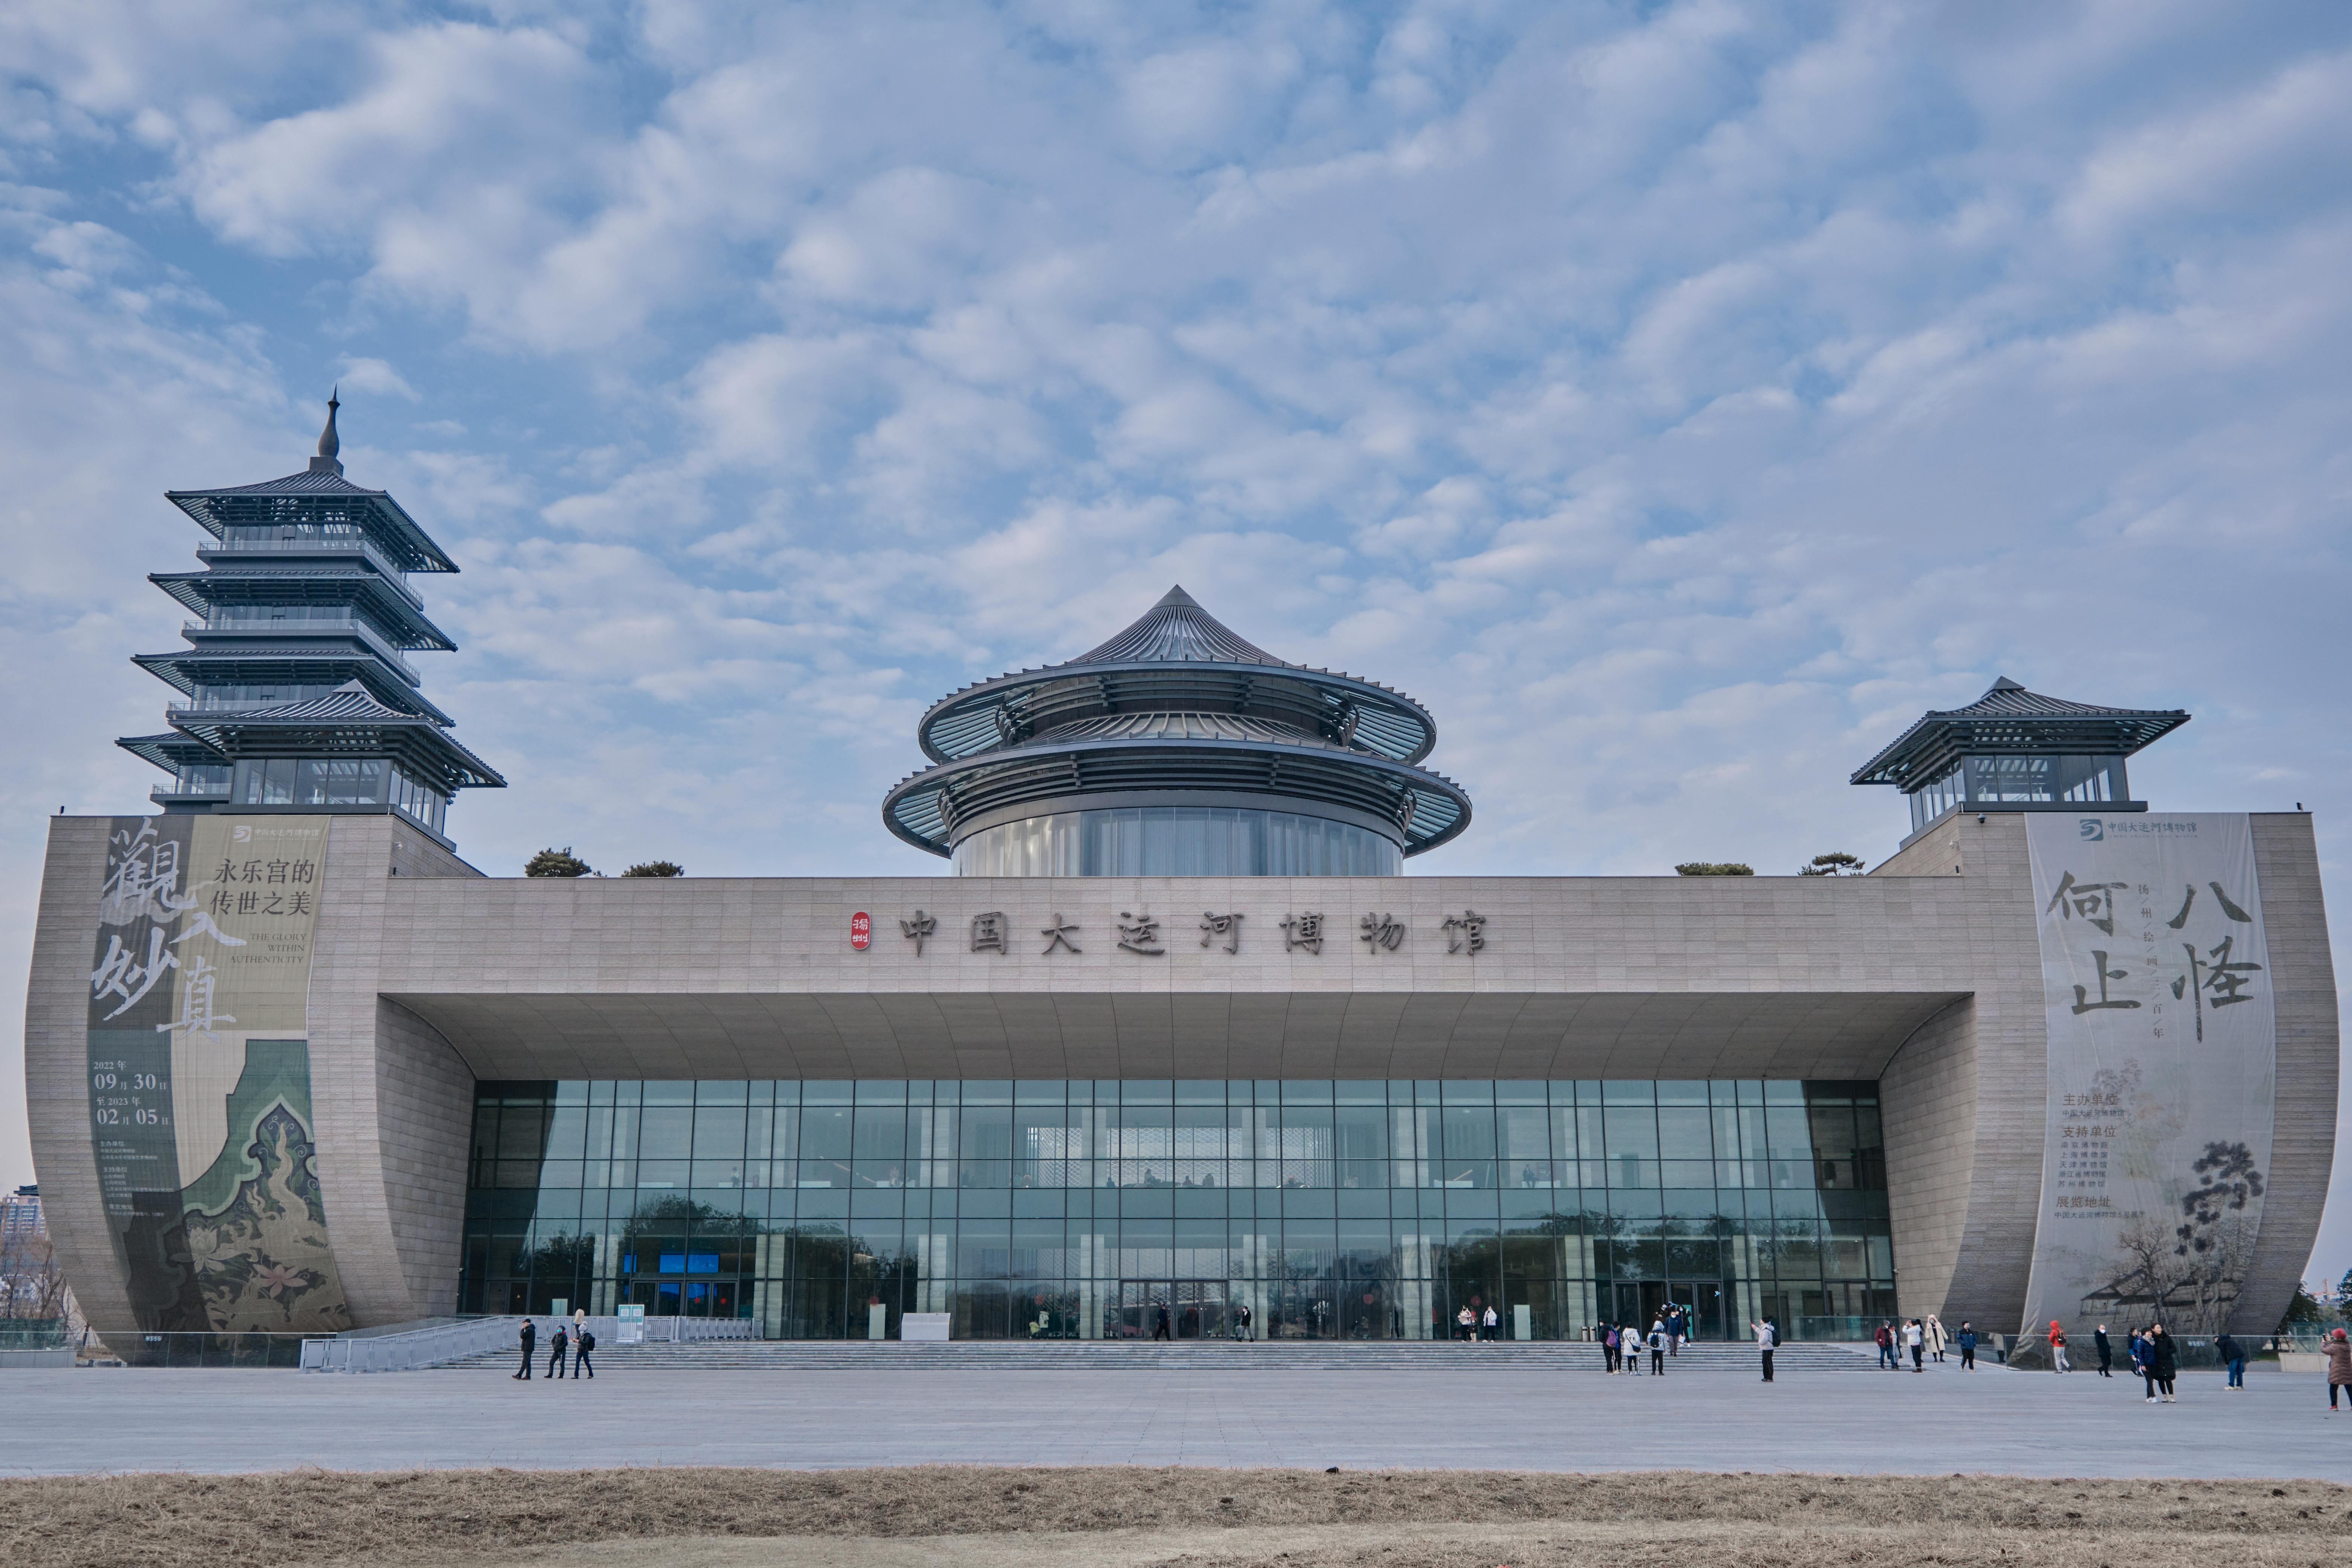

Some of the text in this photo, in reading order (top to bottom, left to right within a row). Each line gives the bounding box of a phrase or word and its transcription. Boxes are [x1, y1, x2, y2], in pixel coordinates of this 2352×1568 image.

[2107, 822, 2197, 833] 中国大运河博物馆
[214, 859, 314, 884] 永乐宫的
[210, 891, 311, 916] 传世之美
[899, 909, 1486, 957] 中国大运河博物馆
[2063, 1093, 2118, 1106] 主办单位
[2062, 1125, 2117, 1138] 支持单位
[2056, 1196, 2111, 1208] 展览地址
[2055, 1211, 2147, 1219] 中国大运河博物馆5号展厅
